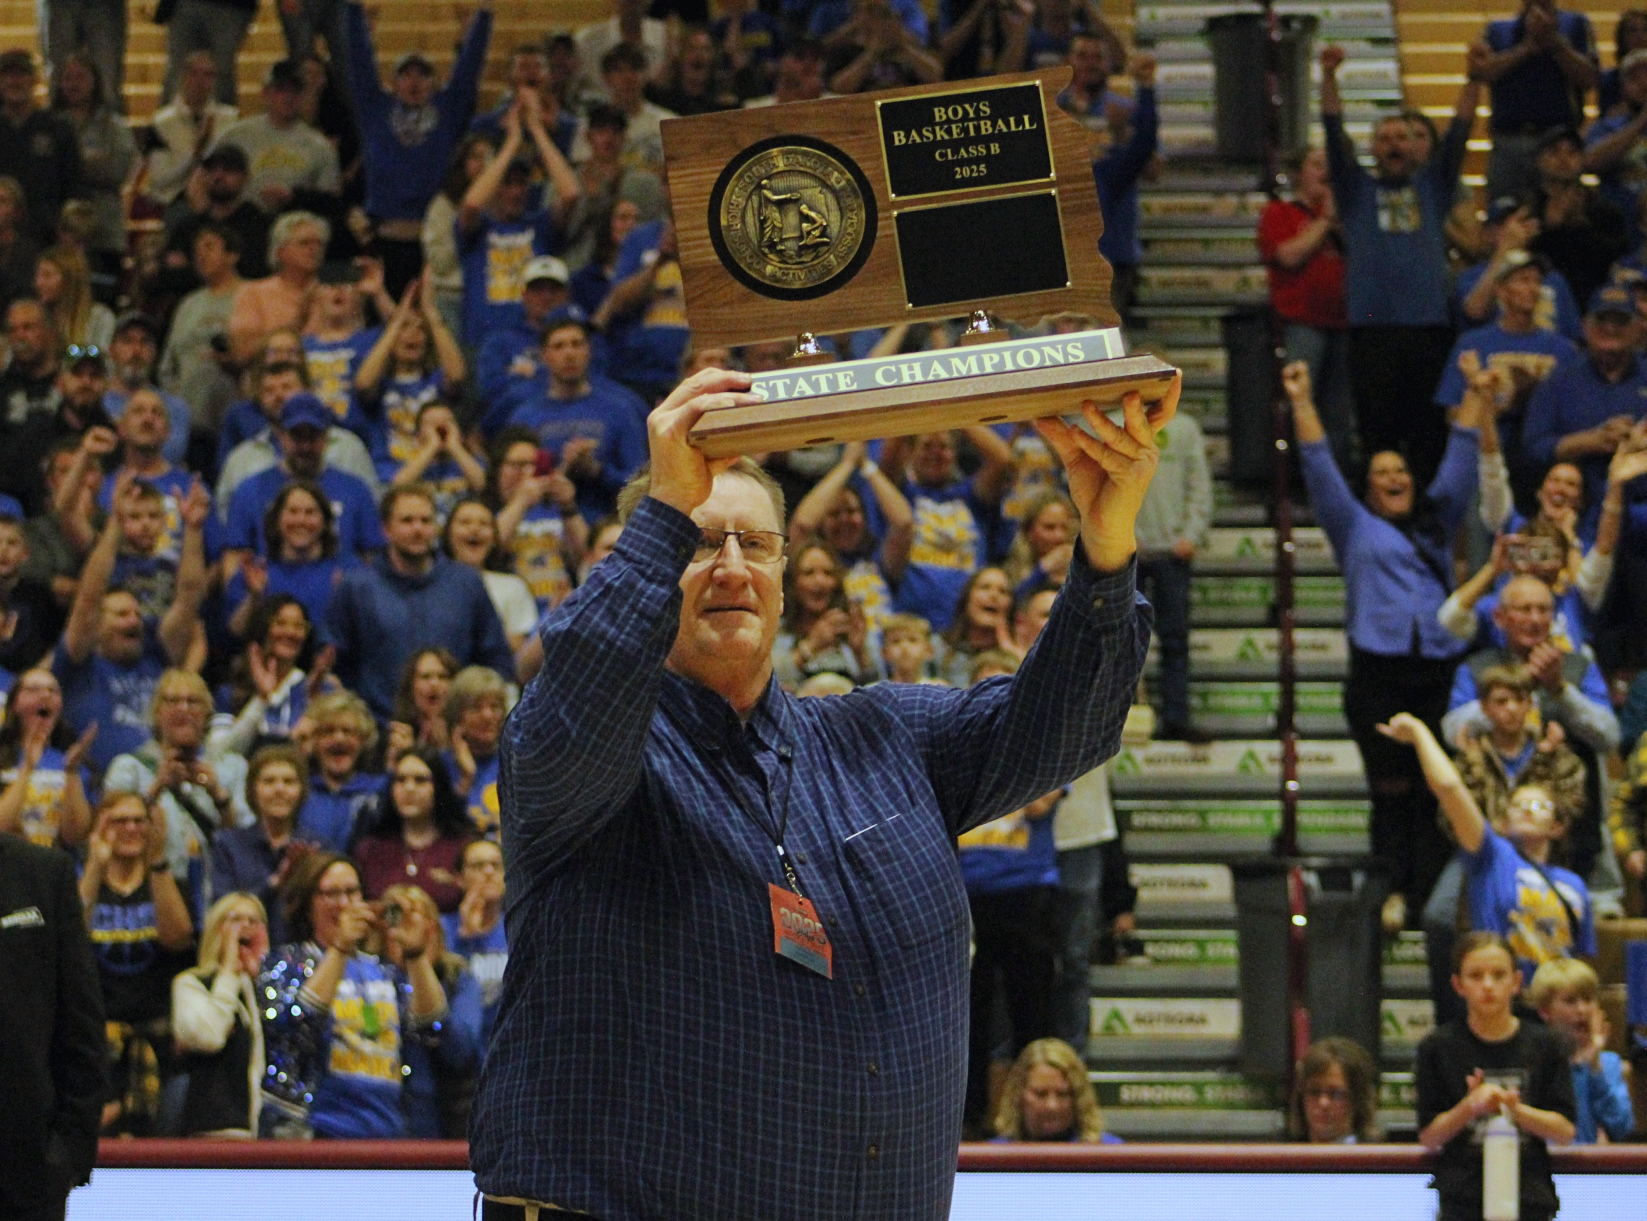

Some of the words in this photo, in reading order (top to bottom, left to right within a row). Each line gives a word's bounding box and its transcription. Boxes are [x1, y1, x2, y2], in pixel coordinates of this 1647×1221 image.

[933, 101, 991, 123] BOYS
[892, 114, 1037, 146] BASKETBALL
[934, 144, 987, 162] CLASS
[990, 142, 1001, 155] B
[954, 163, 987, 179] 2025
[751, 371, 858, 401] STATE
[874, 342, 1085, 386] CHAMPIONS
